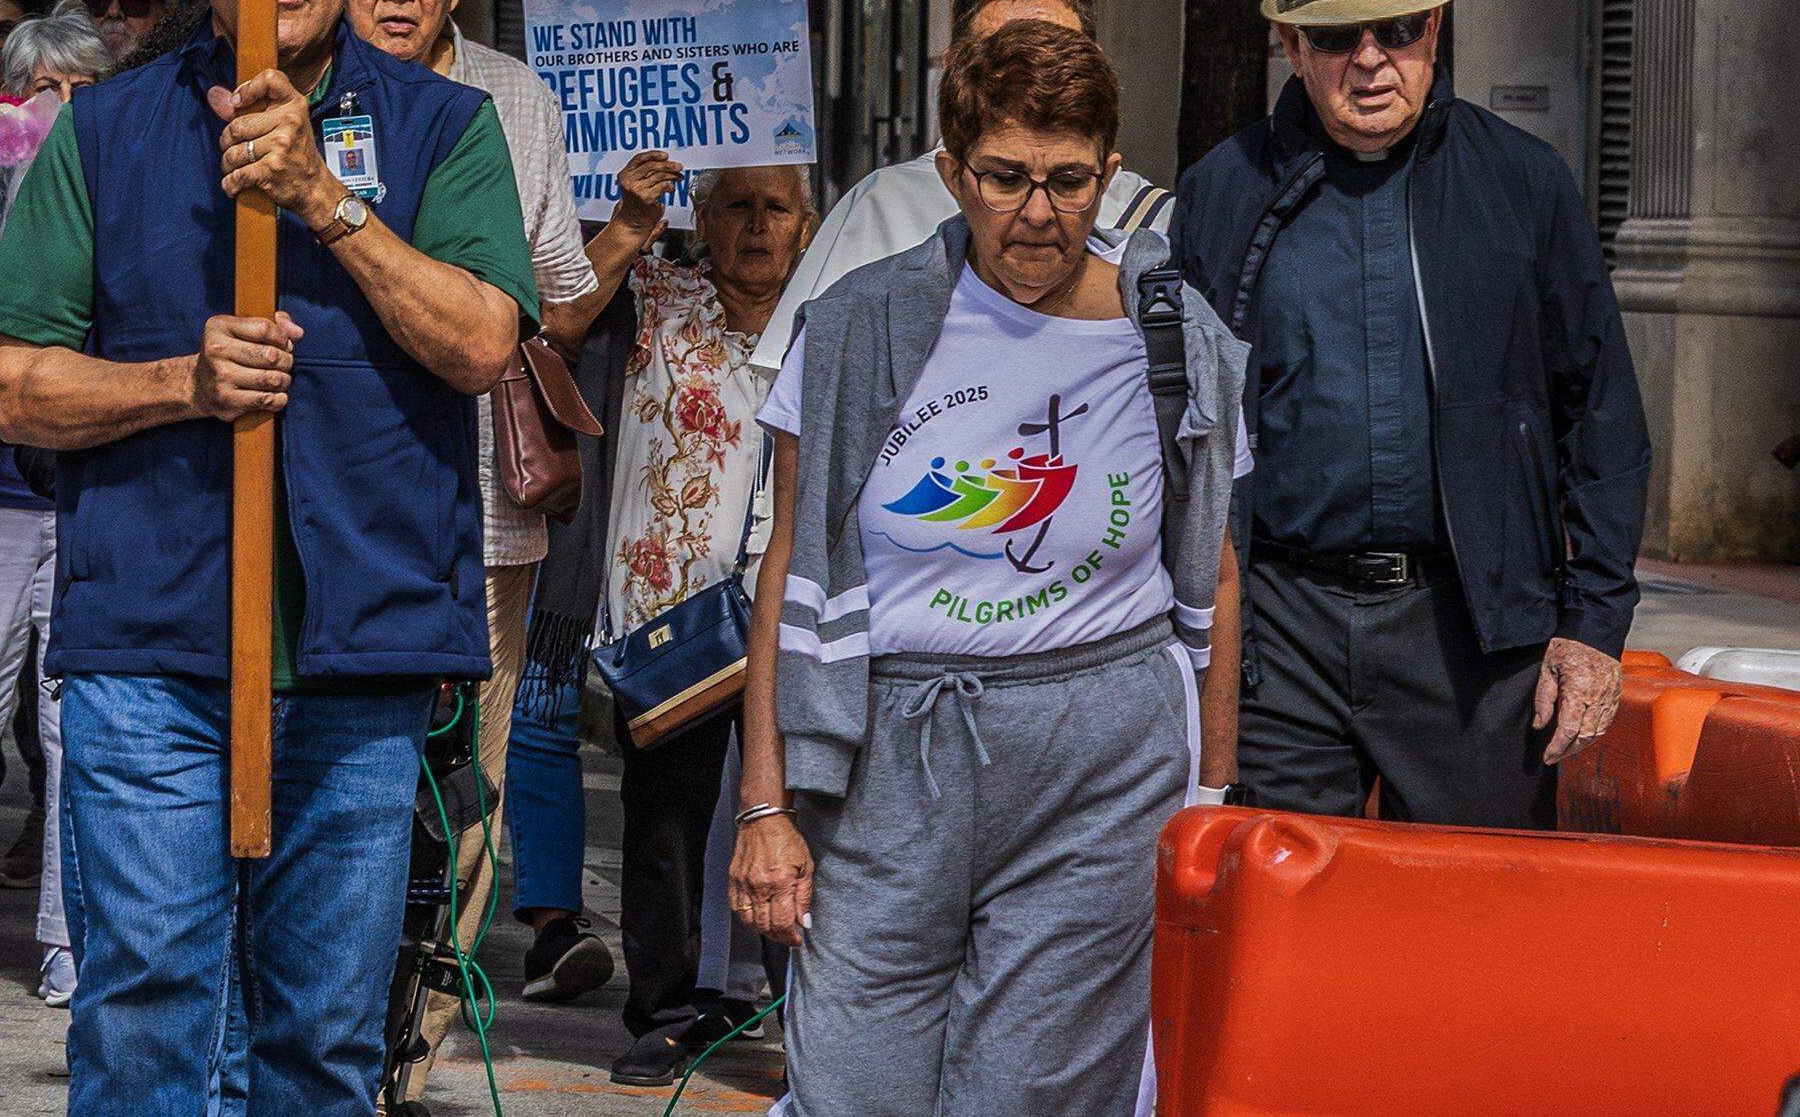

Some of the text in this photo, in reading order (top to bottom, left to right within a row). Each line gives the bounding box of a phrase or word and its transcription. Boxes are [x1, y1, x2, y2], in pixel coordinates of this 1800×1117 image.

[533, 16, 697, 52] WE STAND WITH
[535, 40, 799, 68] OUR BROTHERS AND SISTERS WHO ARE
[711, 61, 734, 103] &
[563, 103, 751, 153] MMIGRANTS
[880, 385, 989, 467] JUBILEE 2025
[929, 470, 1132, 626] PILGRIMS OF HOPE
